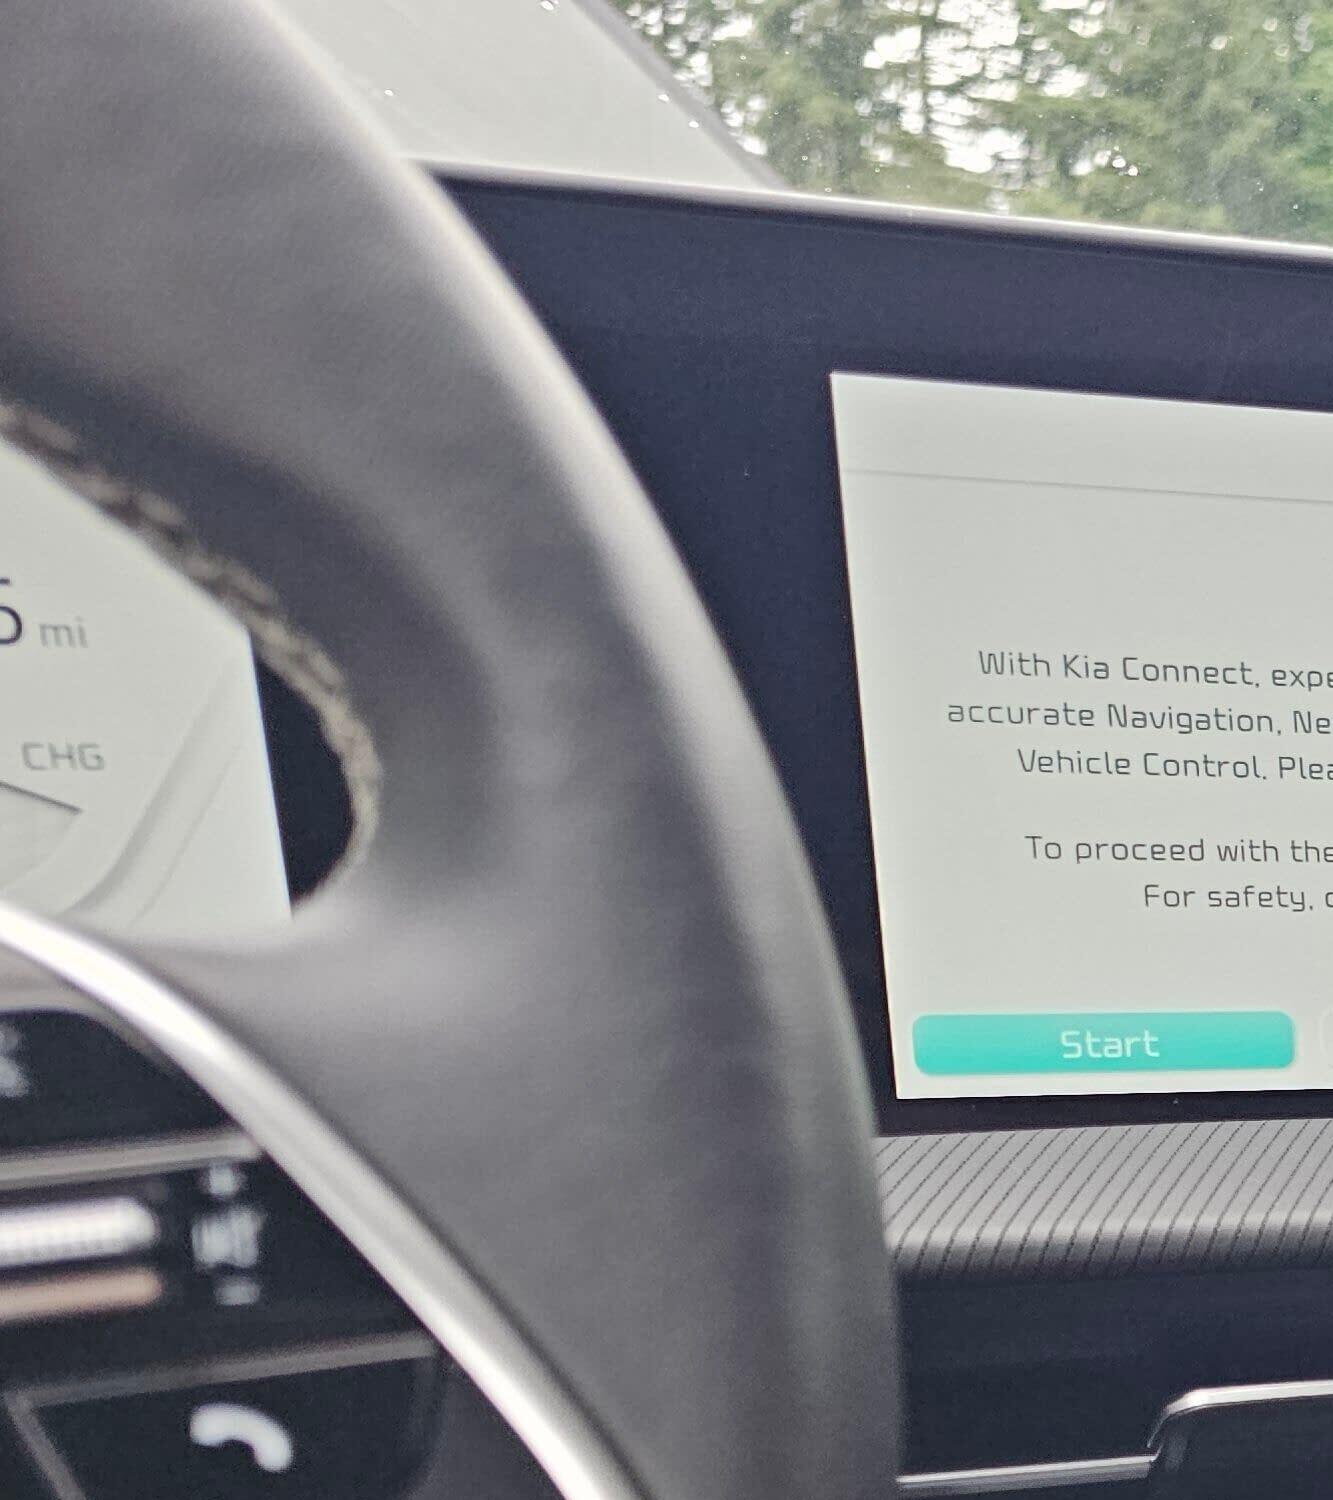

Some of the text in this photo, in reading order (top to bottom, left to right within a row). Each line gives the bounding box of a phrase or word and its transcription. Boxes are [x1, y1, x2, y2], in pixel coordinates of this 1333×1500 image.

[38, 615, 88, 648] mi
[978, 650, 1051, 677] With
[1063, 654, 1110, 680] Kia
[1122, 656, 1260, 689] Connect,
[948, 702, 1095, 727] accurate
[1107, 703, 1282, 735] Navigation,
[21, 742, 105, 771] CHG
[1017, 748, 1131, 775] Vehicle
[1143, 752, 1267, 780] Control.
[1024, 835, 1062, 860] To
[1075, 838, 1205, 864] proceed
[1216, 839, 1279, 862] with
[1144, 884, 1196, 908] For
[1208, 885, 1313, 913] safety,
[1061, 1029, 1160, 1059] Start
